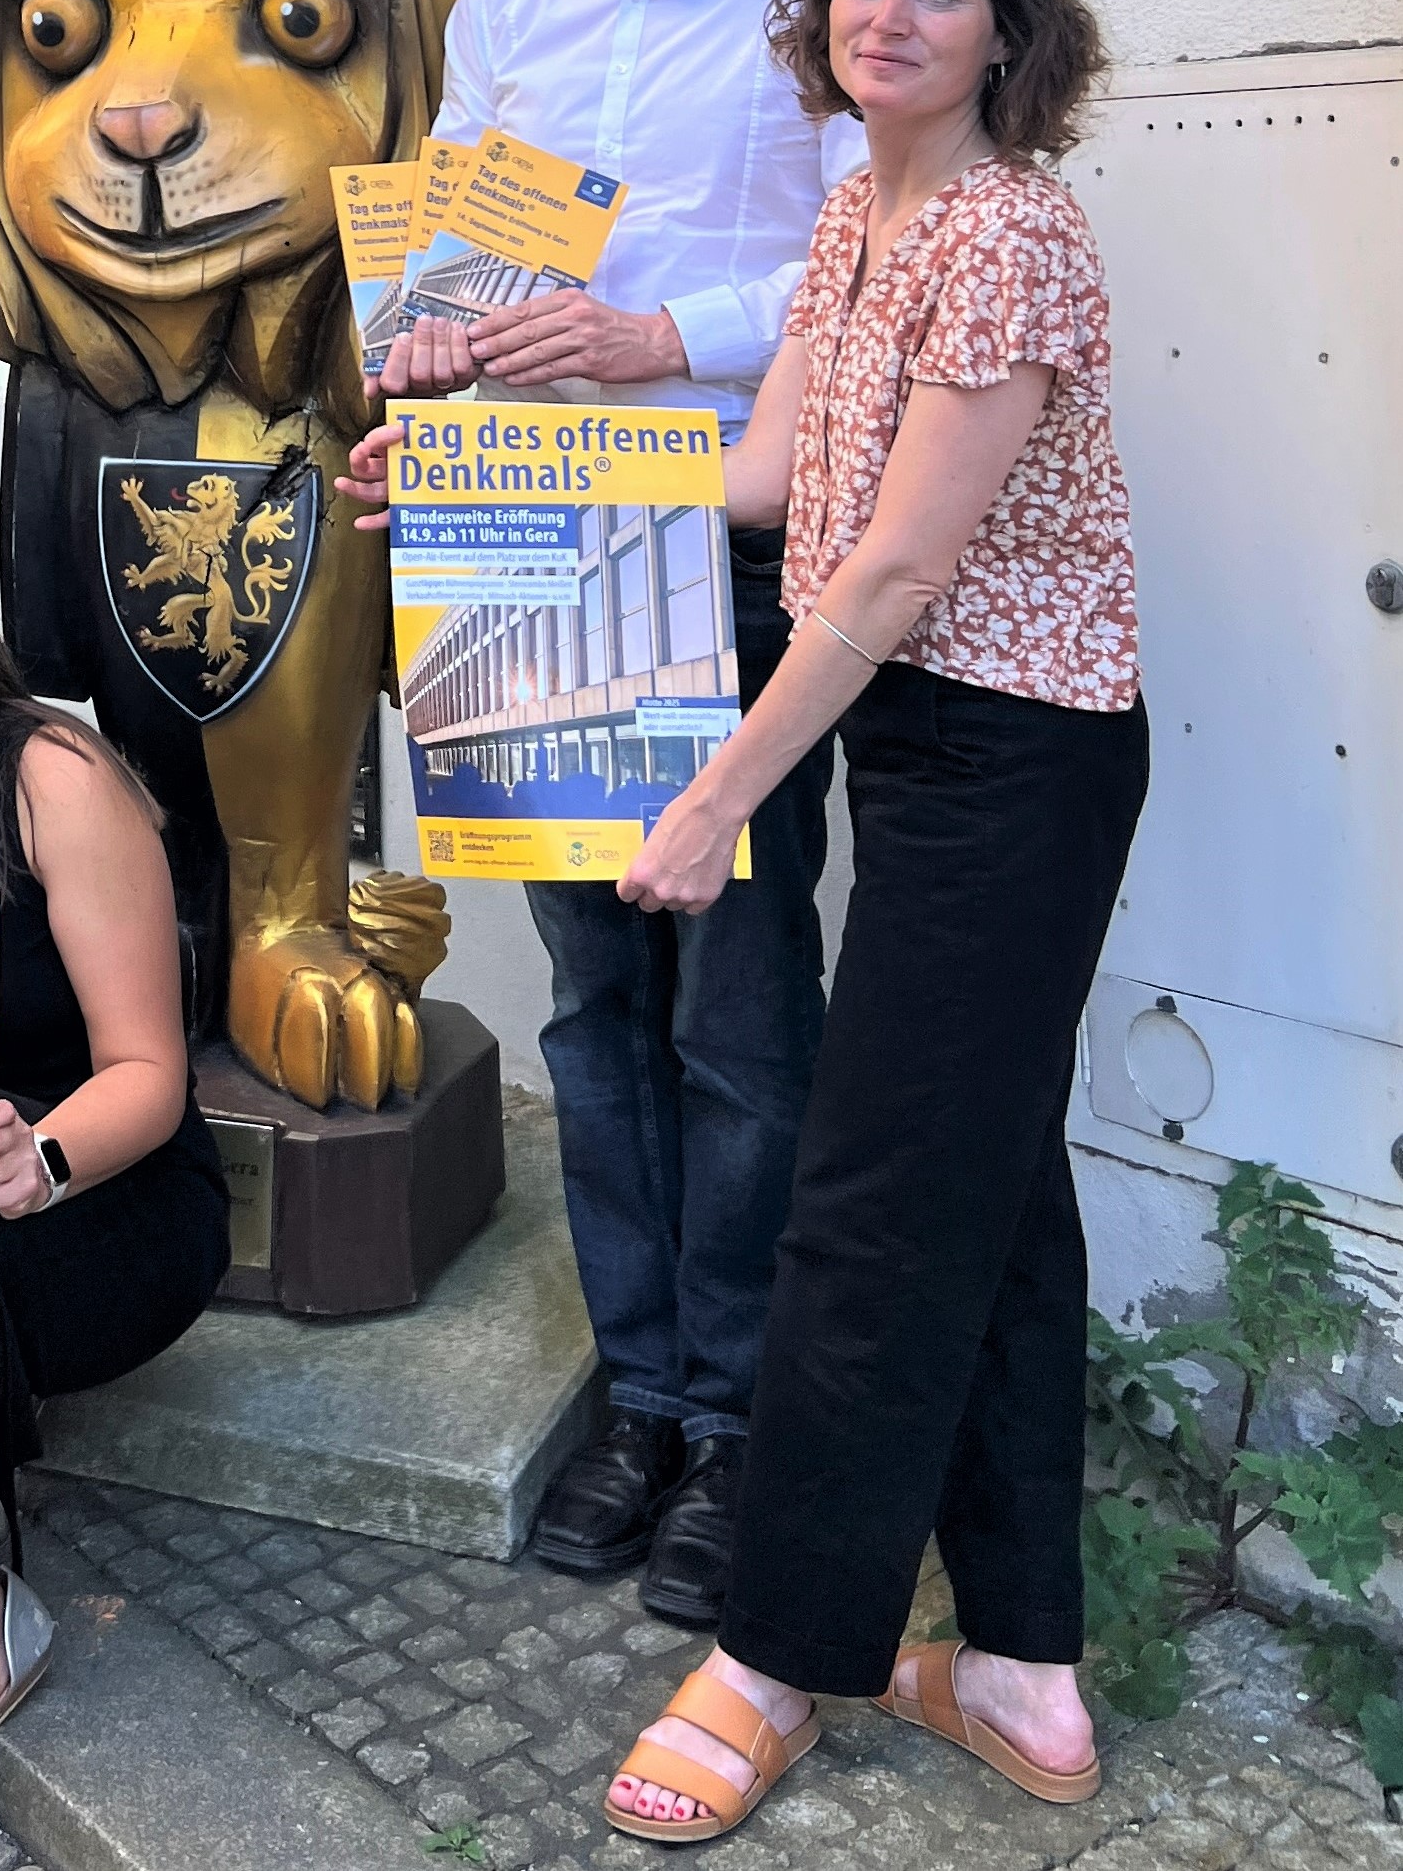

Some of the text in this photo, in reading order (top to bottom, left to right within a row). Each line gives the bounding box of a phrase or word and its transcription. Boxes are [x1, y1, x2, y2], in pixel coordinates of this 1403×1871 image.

[477, 164, 498, 183] Tag
[499, 175, 521, 192] des
[522, 187, 568, 212] offenen
[348, 203, 369, 216] Tag
[372, 202, 393, 214] des
[396, 414, 710, 459] Tag des offenen
[400, 509, 566, 528] Bundesweite Eröffnung
[400, 528, 558, 543] 14.9. ab 11 Uhr in Gera
[402, 551, 461, 563] Open-Air-Event
[463, 551, 477, 562] auf
[477, 551, 495, 562] dem
[497, 551, 516, 562] Platz
[518, 554, 529, 562] vor
[531, 551, 549, 562] dem
